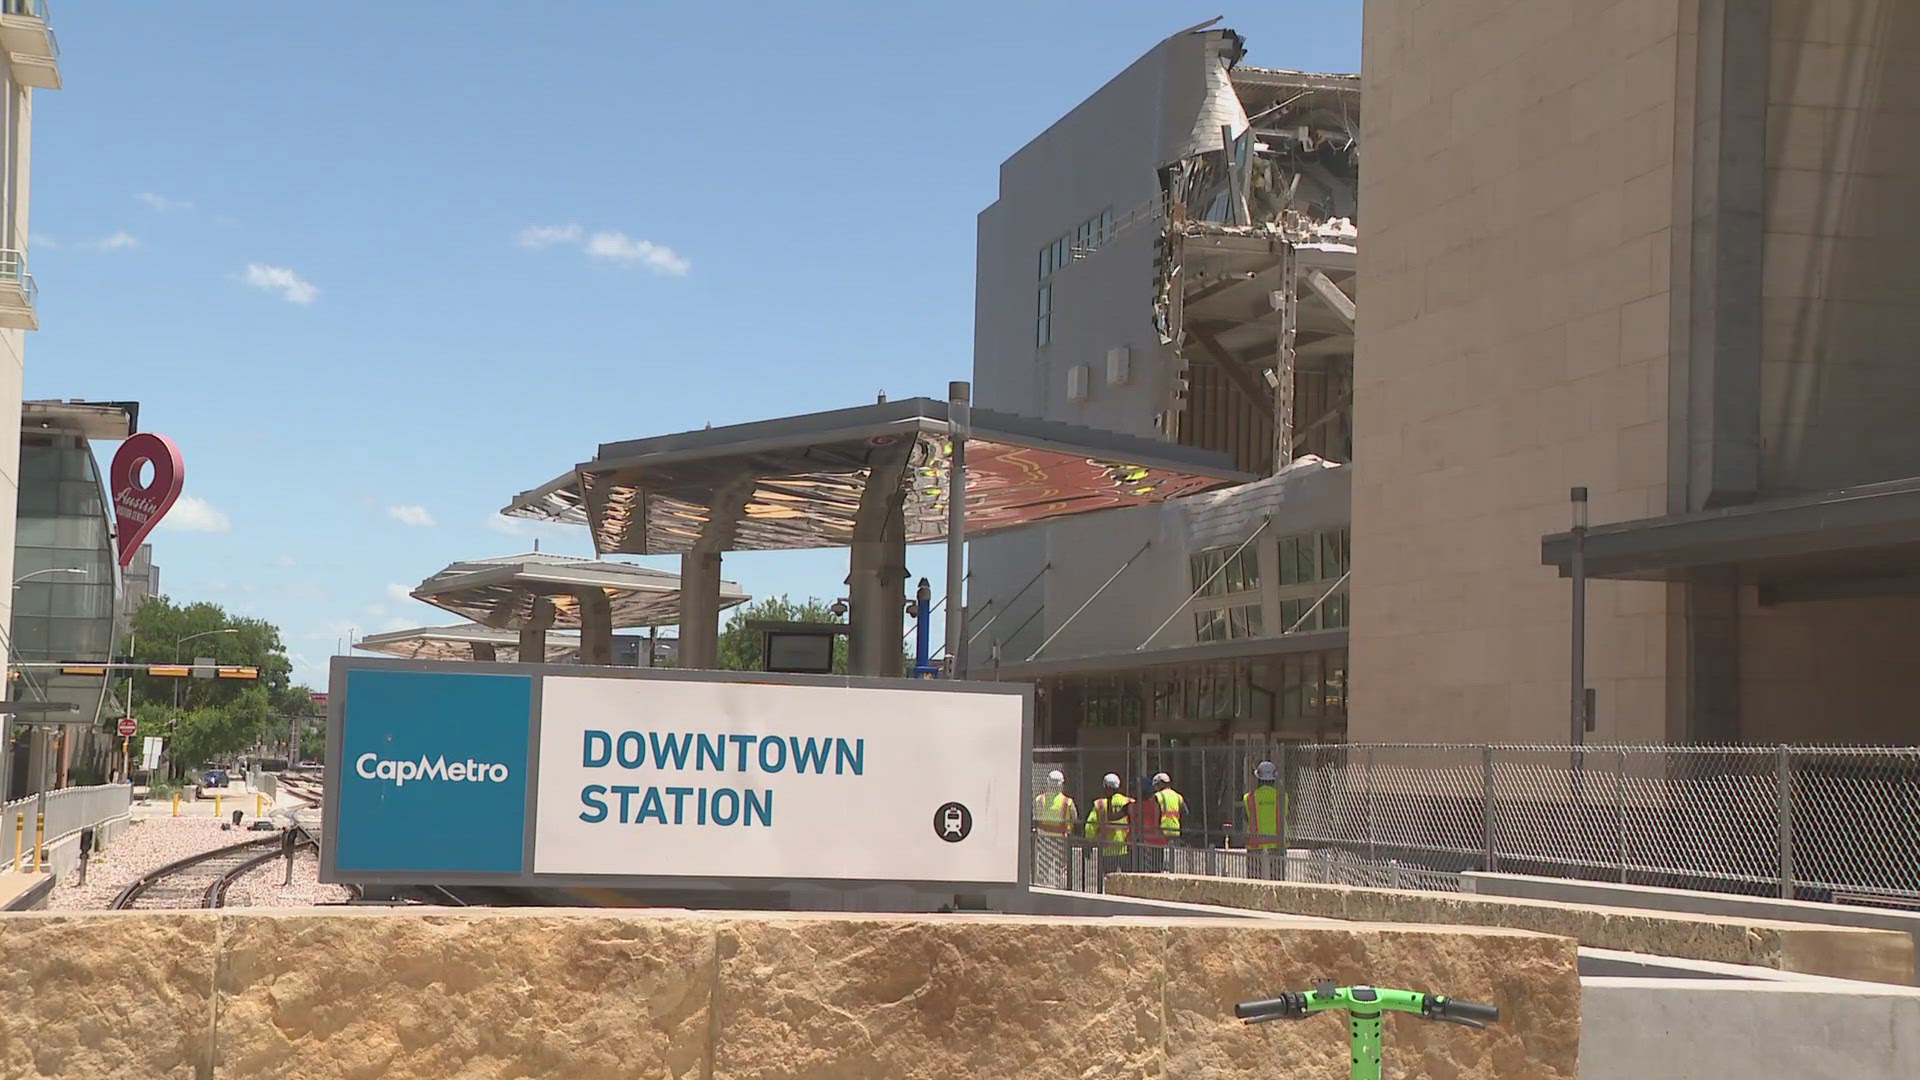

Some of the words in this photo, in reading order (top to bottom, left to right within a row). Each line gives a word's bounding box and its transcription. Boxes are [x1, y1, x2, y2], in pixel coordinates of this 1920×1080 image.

[114, 487, 157, 514] Austin
[356, 753, 508, 786] CapMetro
[582, 730, 864, 775] DOWNTOWN
[579, 784, 773, 827] STATION
